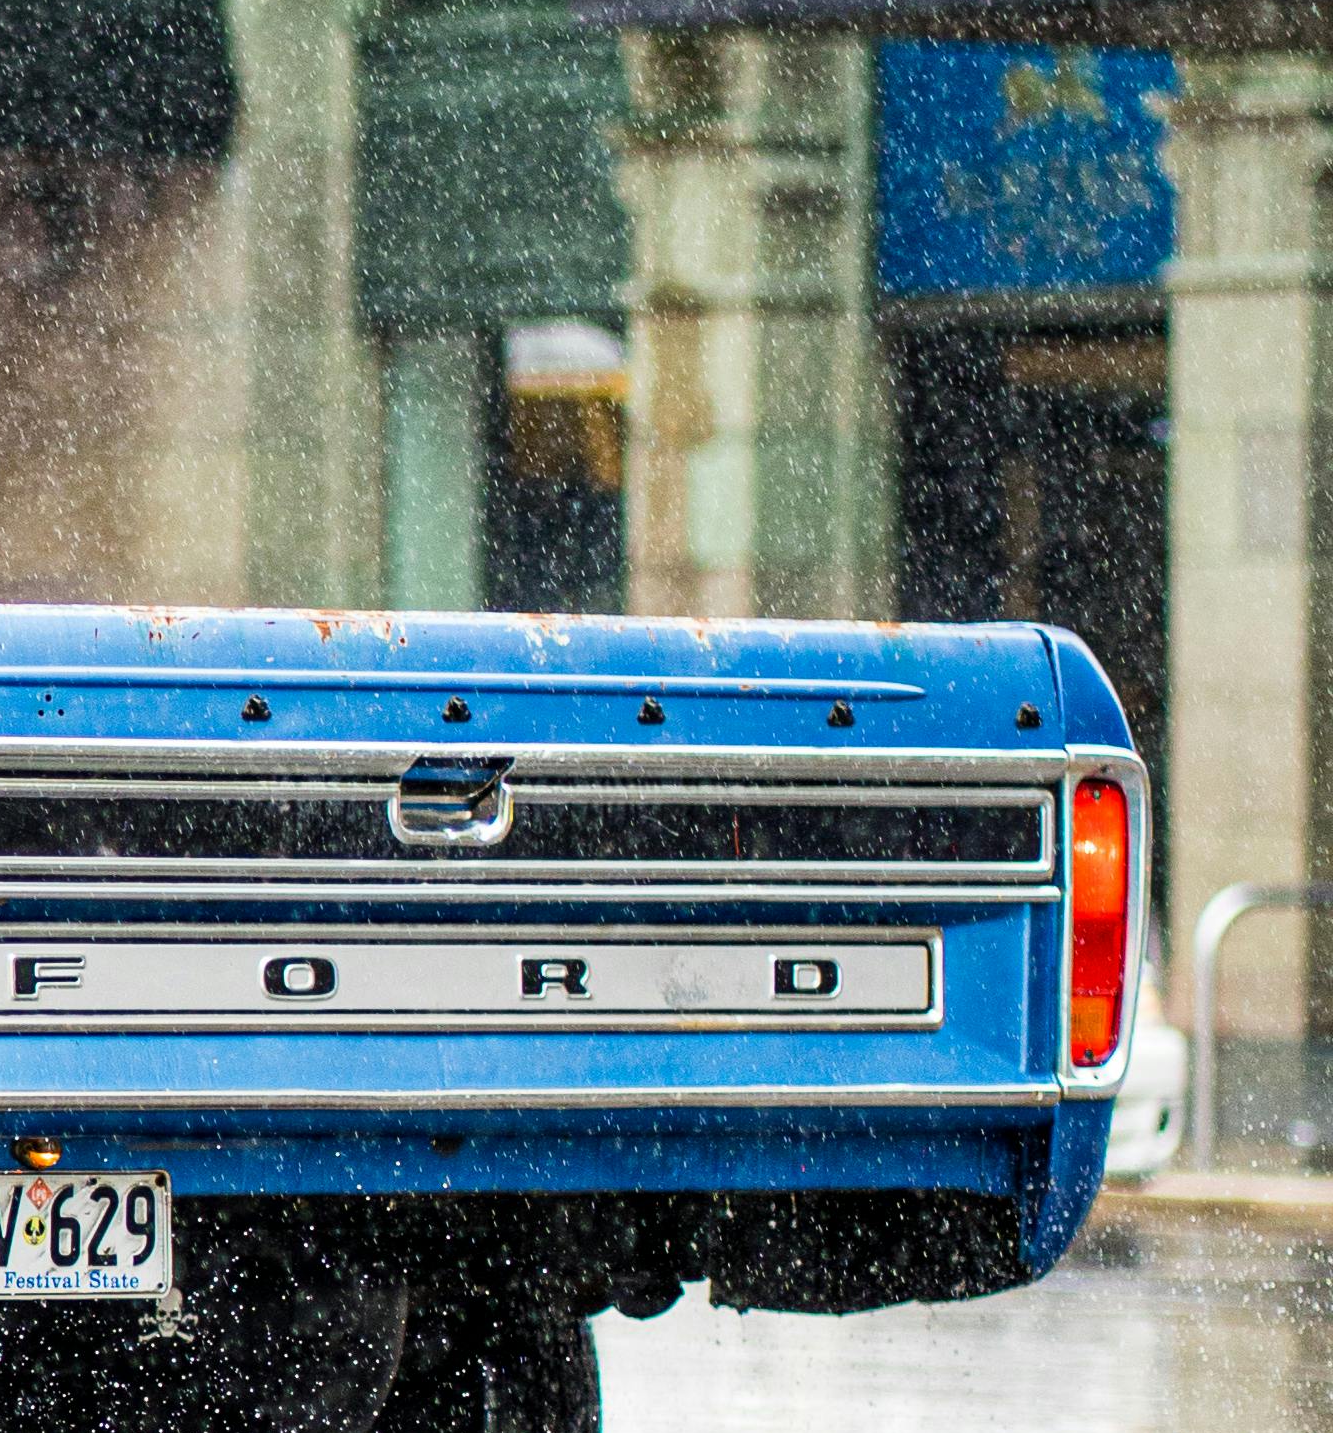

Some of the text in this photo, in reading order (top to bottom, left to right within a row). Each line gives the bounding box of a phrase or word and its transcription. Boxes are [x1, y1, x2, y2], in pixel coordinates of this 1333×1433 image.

[10, 954, 844, 1000] FORD
[49, 1184, 156, 1267] 629
[4, 1271, 82, 1289] Festival
[88, 1269, 140, 1289] State
